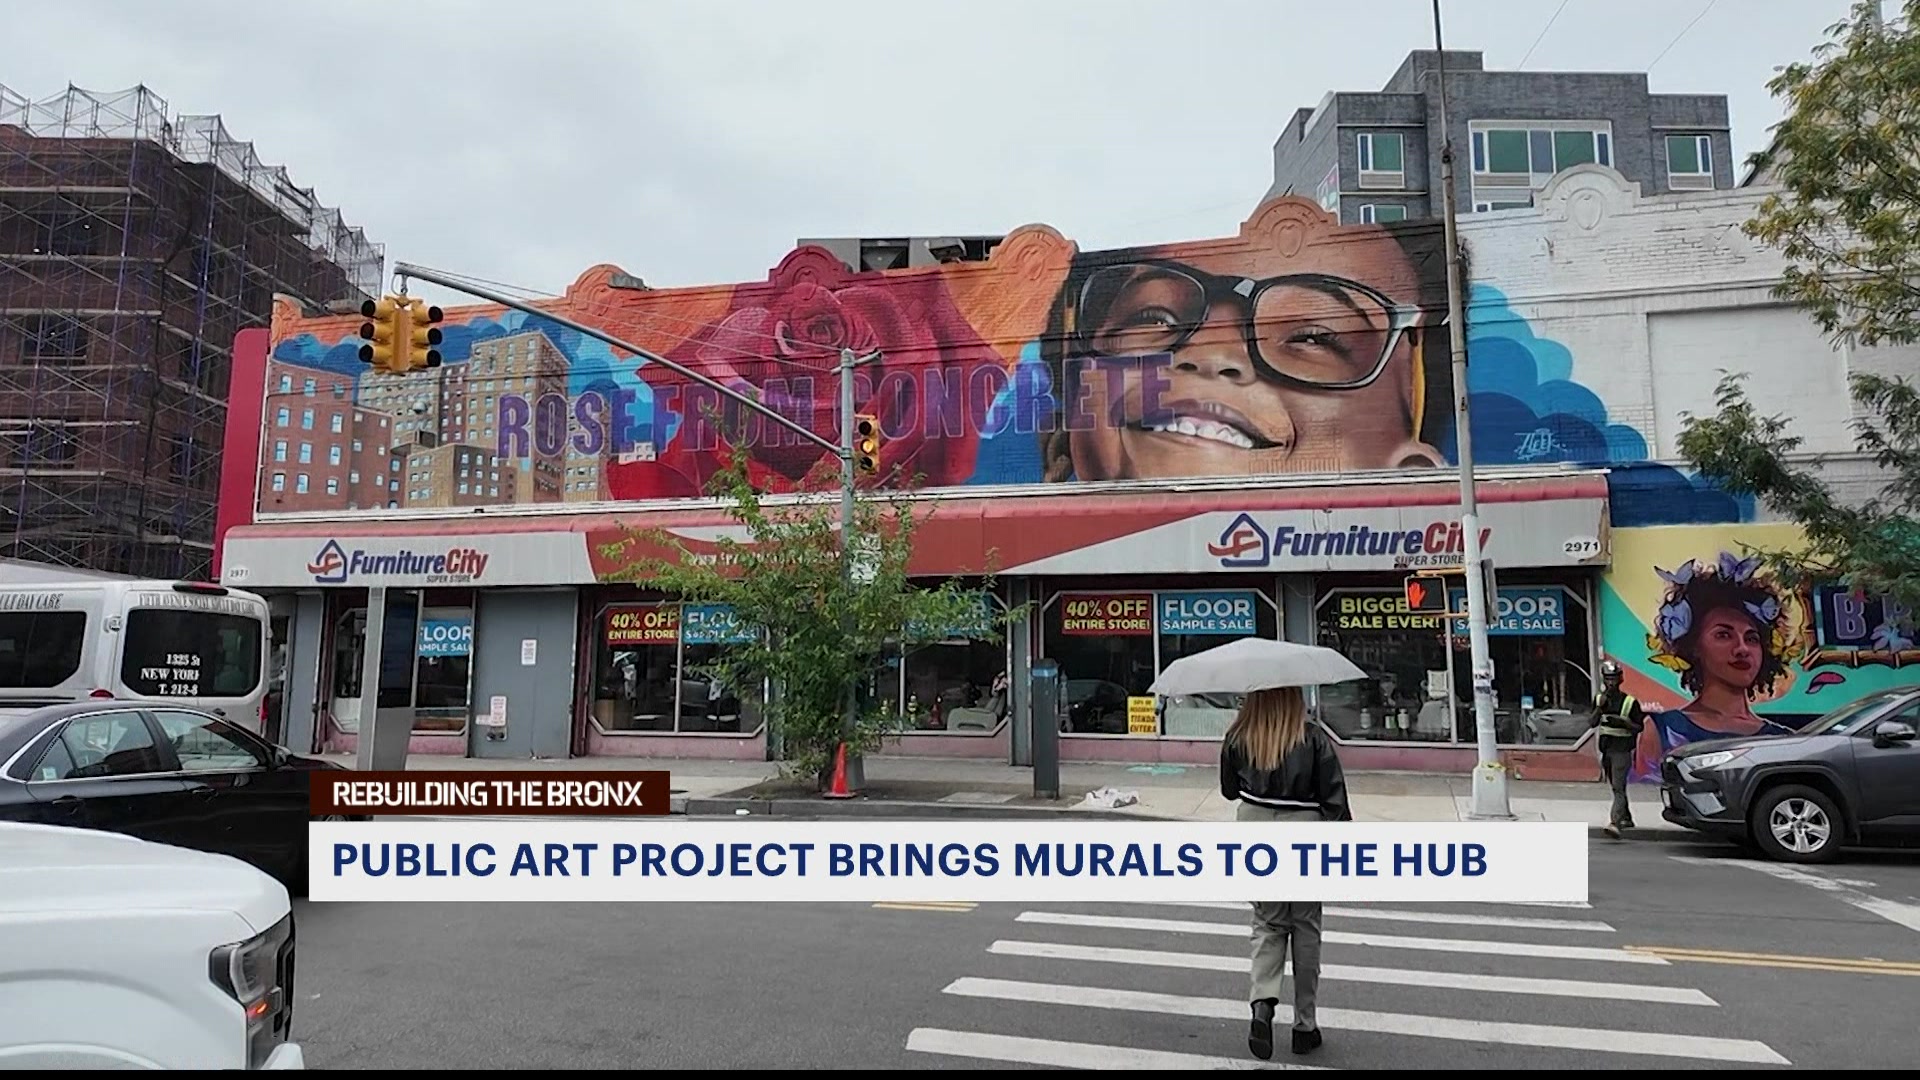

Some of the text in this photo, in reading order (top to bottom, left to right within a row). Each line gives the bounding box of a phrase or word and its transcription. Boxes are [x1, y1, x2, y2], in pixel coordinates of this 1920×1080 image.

[497, 351, 1176, 459] ROSE FROM CONCRETE
[1564, 541, 1599, 552] 2971
[350, 548, 489, 579] FurnitureCity
[1394, 554, 1464, 566] SUPER STORE
[230, 569, 249, 578] 2971
[426, 574, 471, 583] SUPER STORE
[1066, 599, 1148, 617] 40% OFF
[1164, 598, 1251, 618] FLOOR
[1341, 597, 1408, 614] BIGGE
[1458, 597, 1558, 617] FOOR
[611, 611, 677, 628] 40% OFF
[1063, 618, 1151, 630] ENTIRE STORE!
[1162, 619, 1253, 631] SAMPLE SALE
[1339, 615, 1440, 629] SALE EVER!
[1522, 618, 1562, 630] SALE
[420, 625, 472, 641] LOOR
[607, 629, 643, 640] ENTIRE
[450, 642, 470, 652] SAL
[140, 667, 171, 680] NEW
